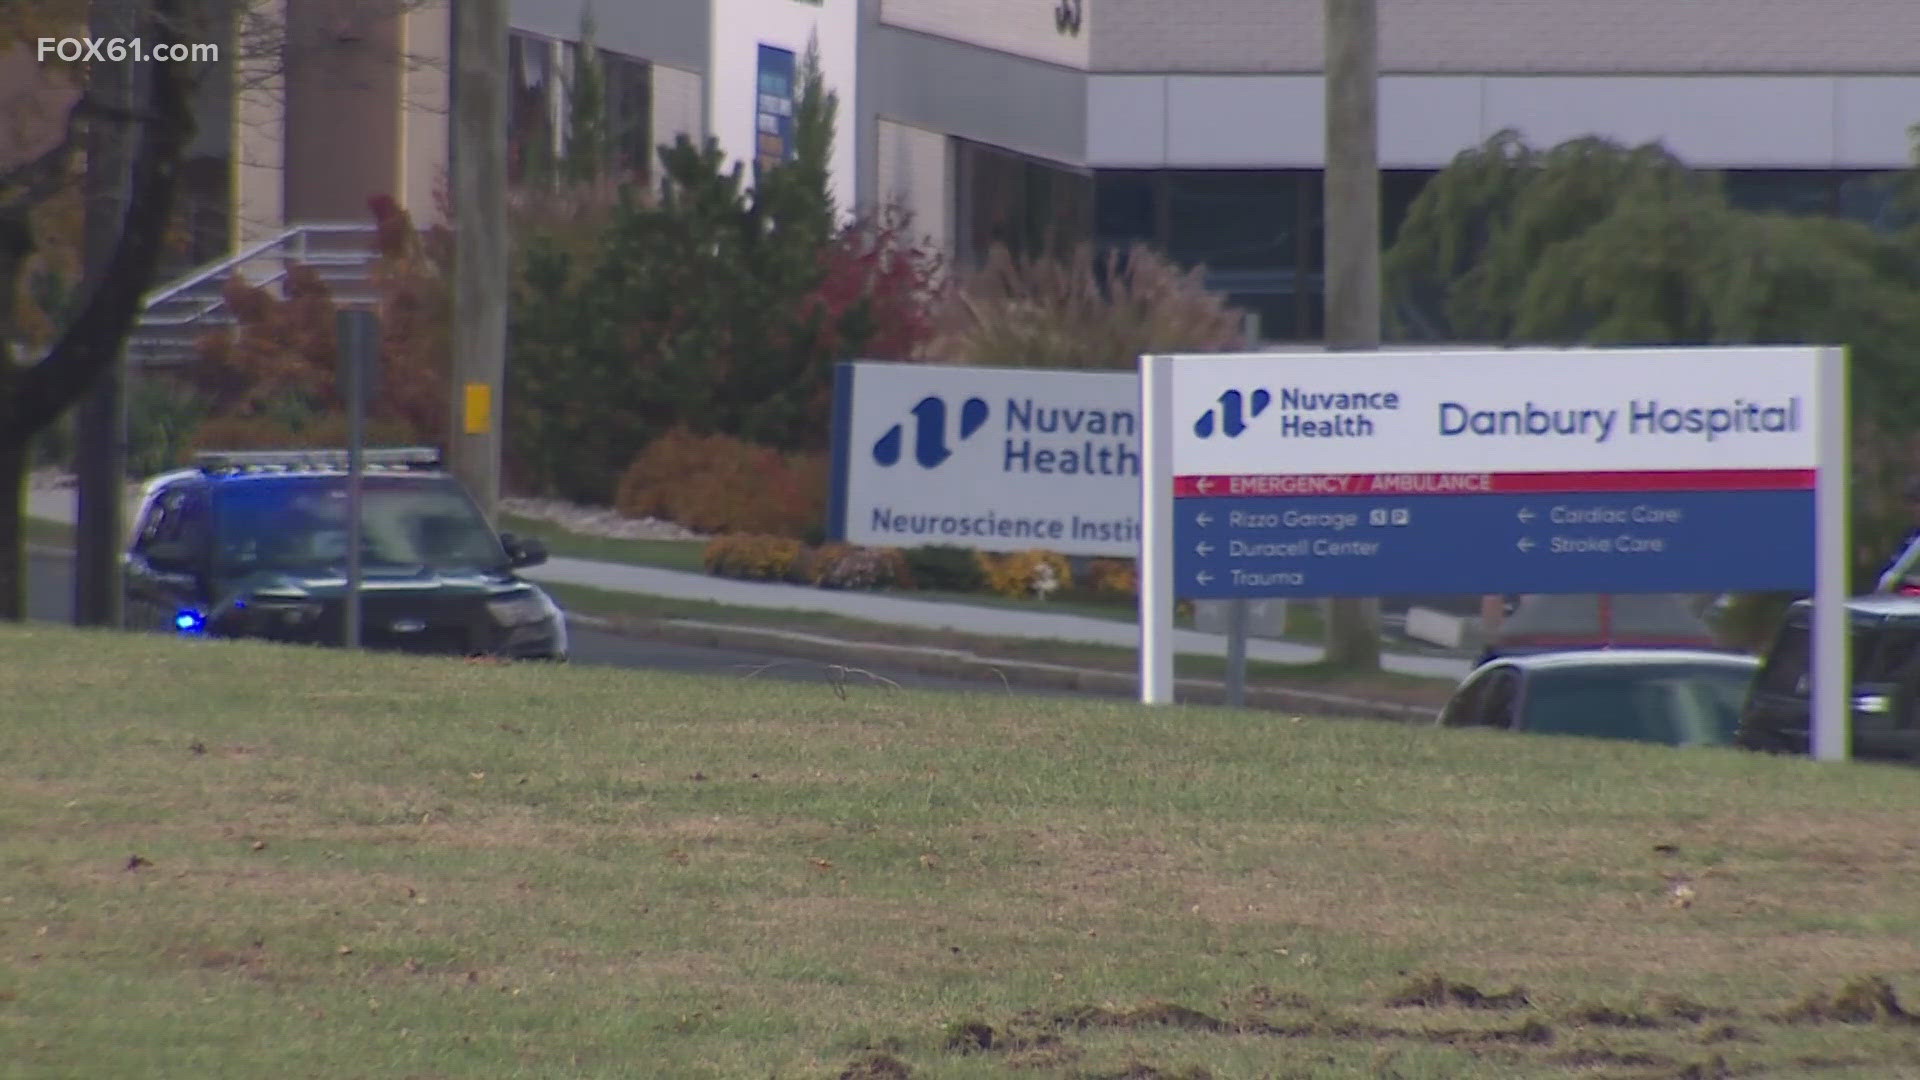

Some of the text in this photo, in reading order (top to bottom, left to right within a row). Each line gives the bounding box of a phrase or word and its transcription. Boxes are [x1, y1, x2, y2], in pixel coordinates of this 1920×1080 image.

[1281, 388, 1399, 411] Nuvance
[1005, 398, 1136, 436] Nuvan
[1281, 415, 1374, 438] Health
[1439, 397, 1801, 443] Danbury Hospital
[1004, 440, 1139, 476] Health
[1229, 477, 1350, 494] EMERGENCY
[1370, 475, 1492, 492] AMBULANCE
[872, 507, 1065, 540] Neuroscience
[1229, 511, 1278, 528] Rizzo
[1283, 511, 1358, 531] Garage
[1550, 504, 1682, 524] Cardiac Care
[1229, 538, 1380, 557] Duracell Center
[1550, 535, 1664, 553] Stroke Care
[1229, 569, 1304, 586] Trauma
